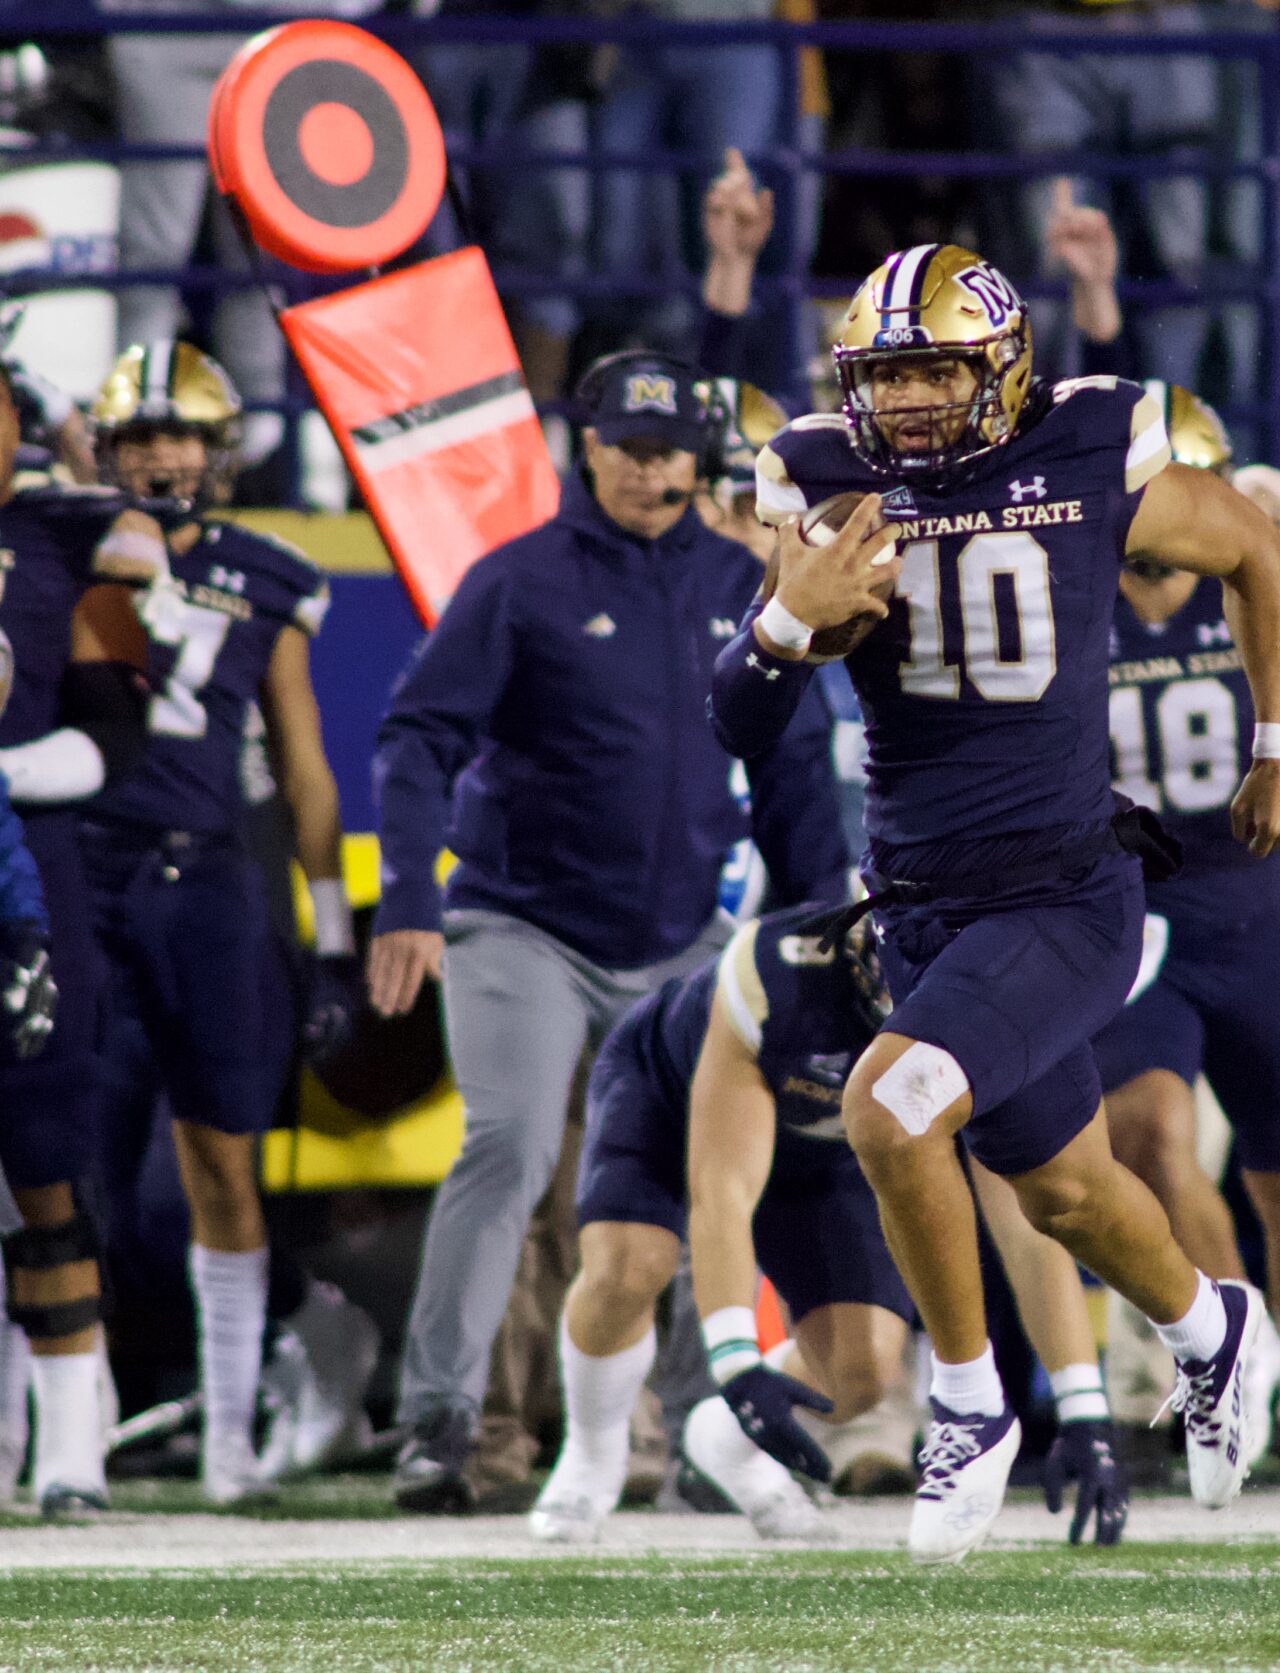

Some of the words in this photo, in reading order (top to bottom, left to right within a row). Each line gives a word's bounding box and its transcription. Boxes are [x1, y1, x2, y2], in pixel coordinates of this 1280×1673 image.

[953, 261, 1023, 333] M
[882, 328, 914, 344] 406
[625, 373, 677, 415] M
[900, 510, 993, 540] NTANA
[1002, 500, 1084, 529] STATE
[895, 530, 1058, 702] 10
[148, 603, 232, 738] 7
[1108, 677, 1240, 815] 18
